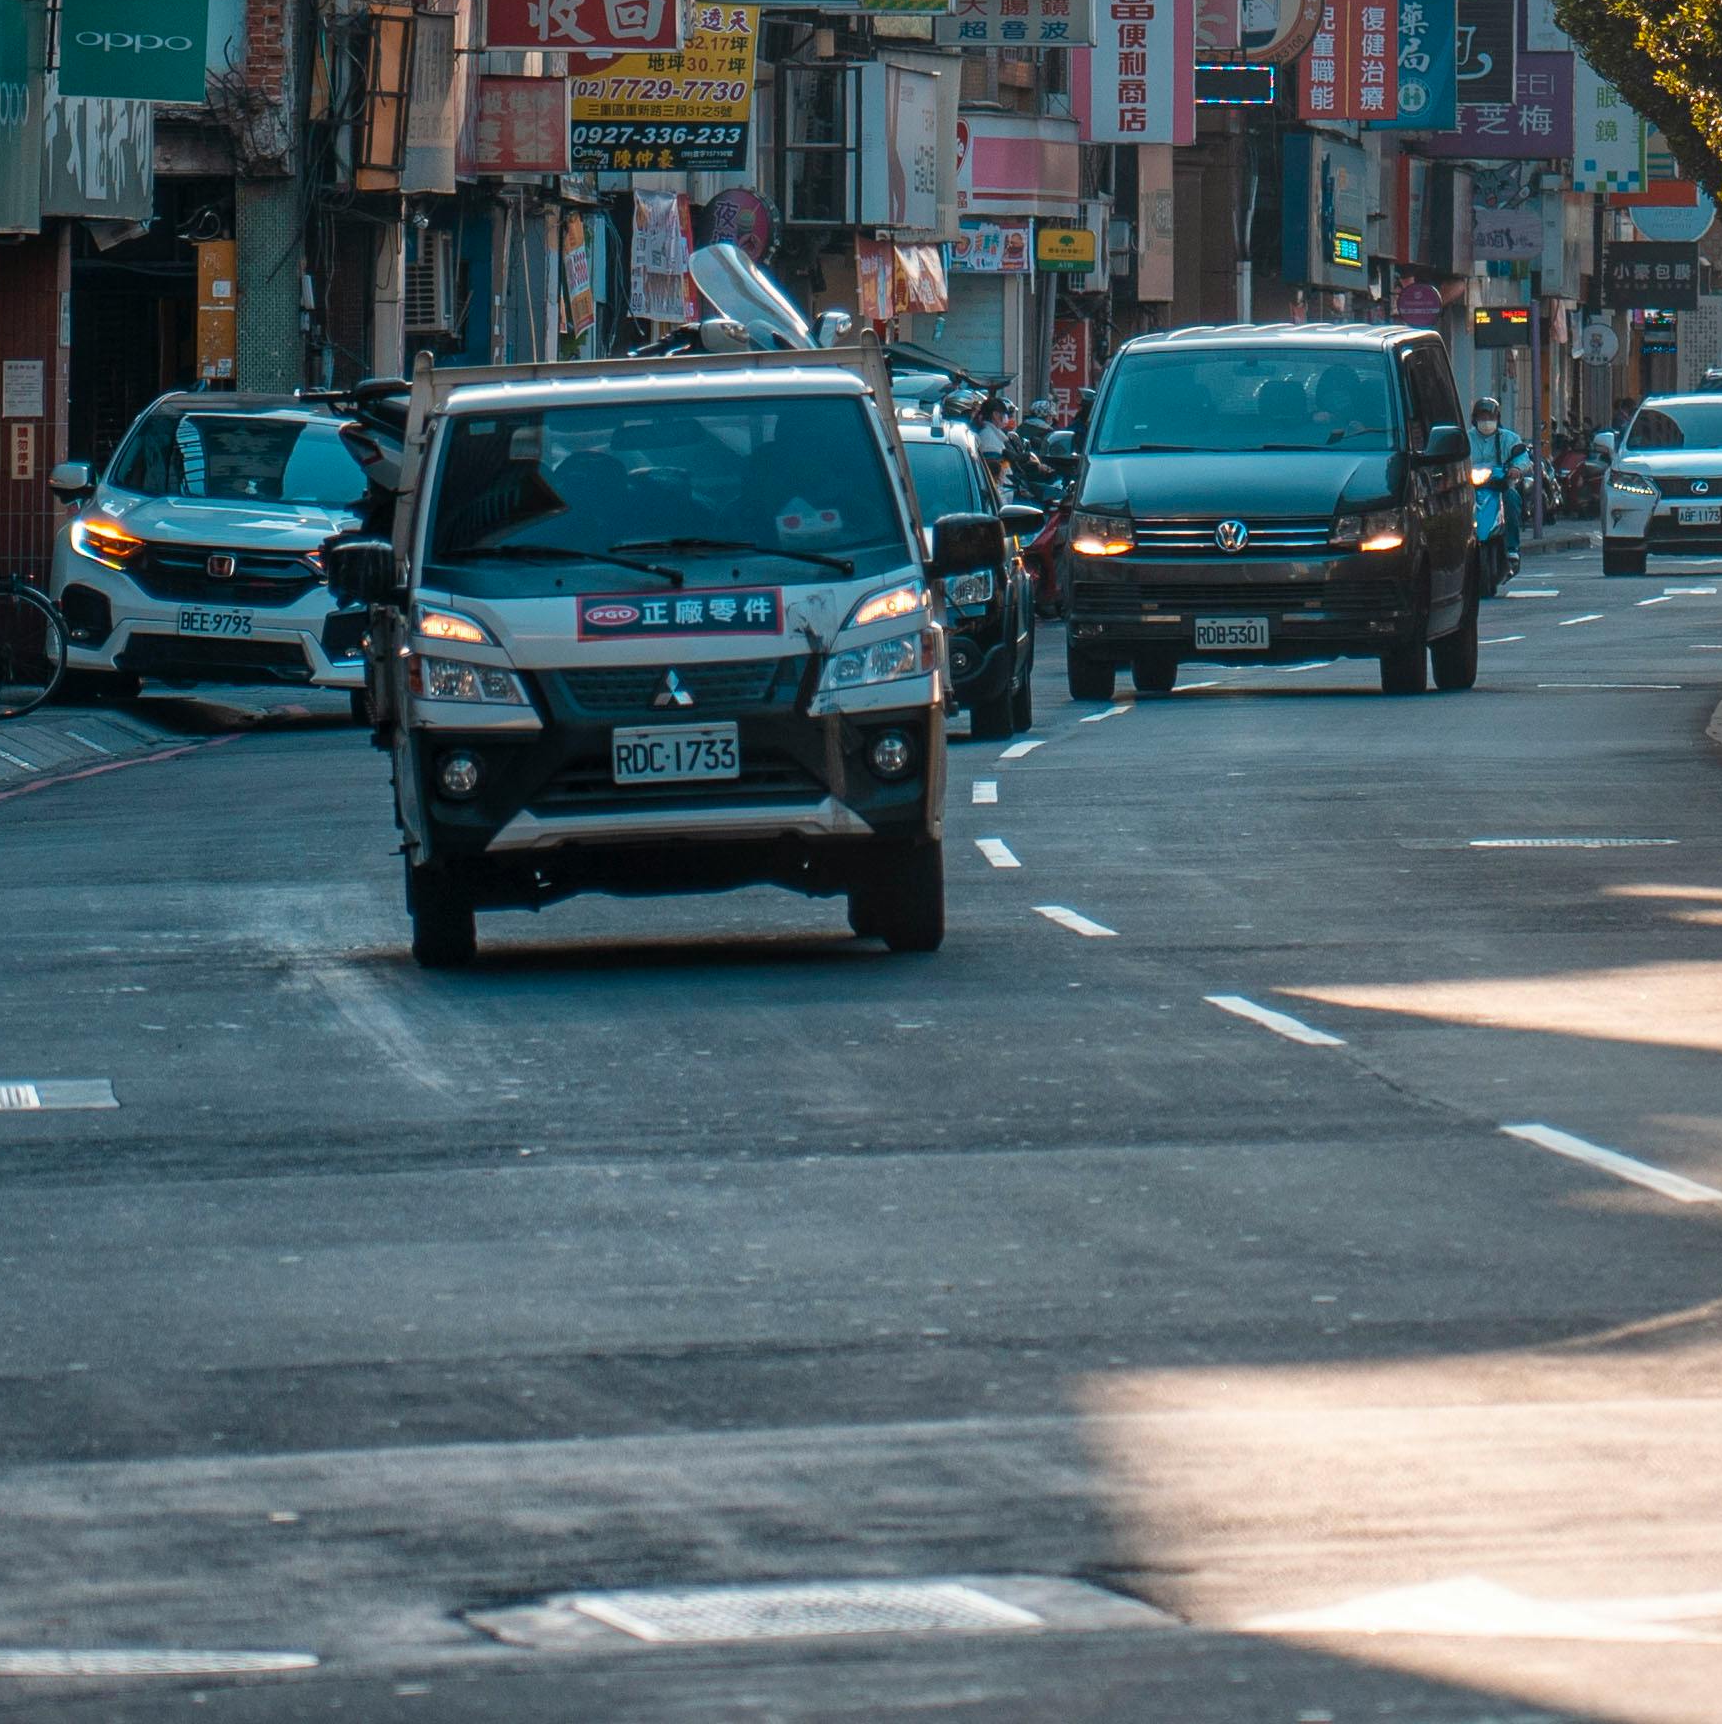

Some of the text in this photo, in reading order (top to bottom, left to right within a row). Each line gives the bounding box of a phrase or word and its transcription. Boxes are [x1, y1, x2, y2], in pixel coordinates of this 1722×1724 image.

[958, 20, 1070, 40] 超音波
[76, 31, 192, 53] oppo
[1360, 6, 1386, 111] 復健治療
[573, 127, 741, 144] 0927-336-233
[641, 597, 772, 625] 正廠零件
